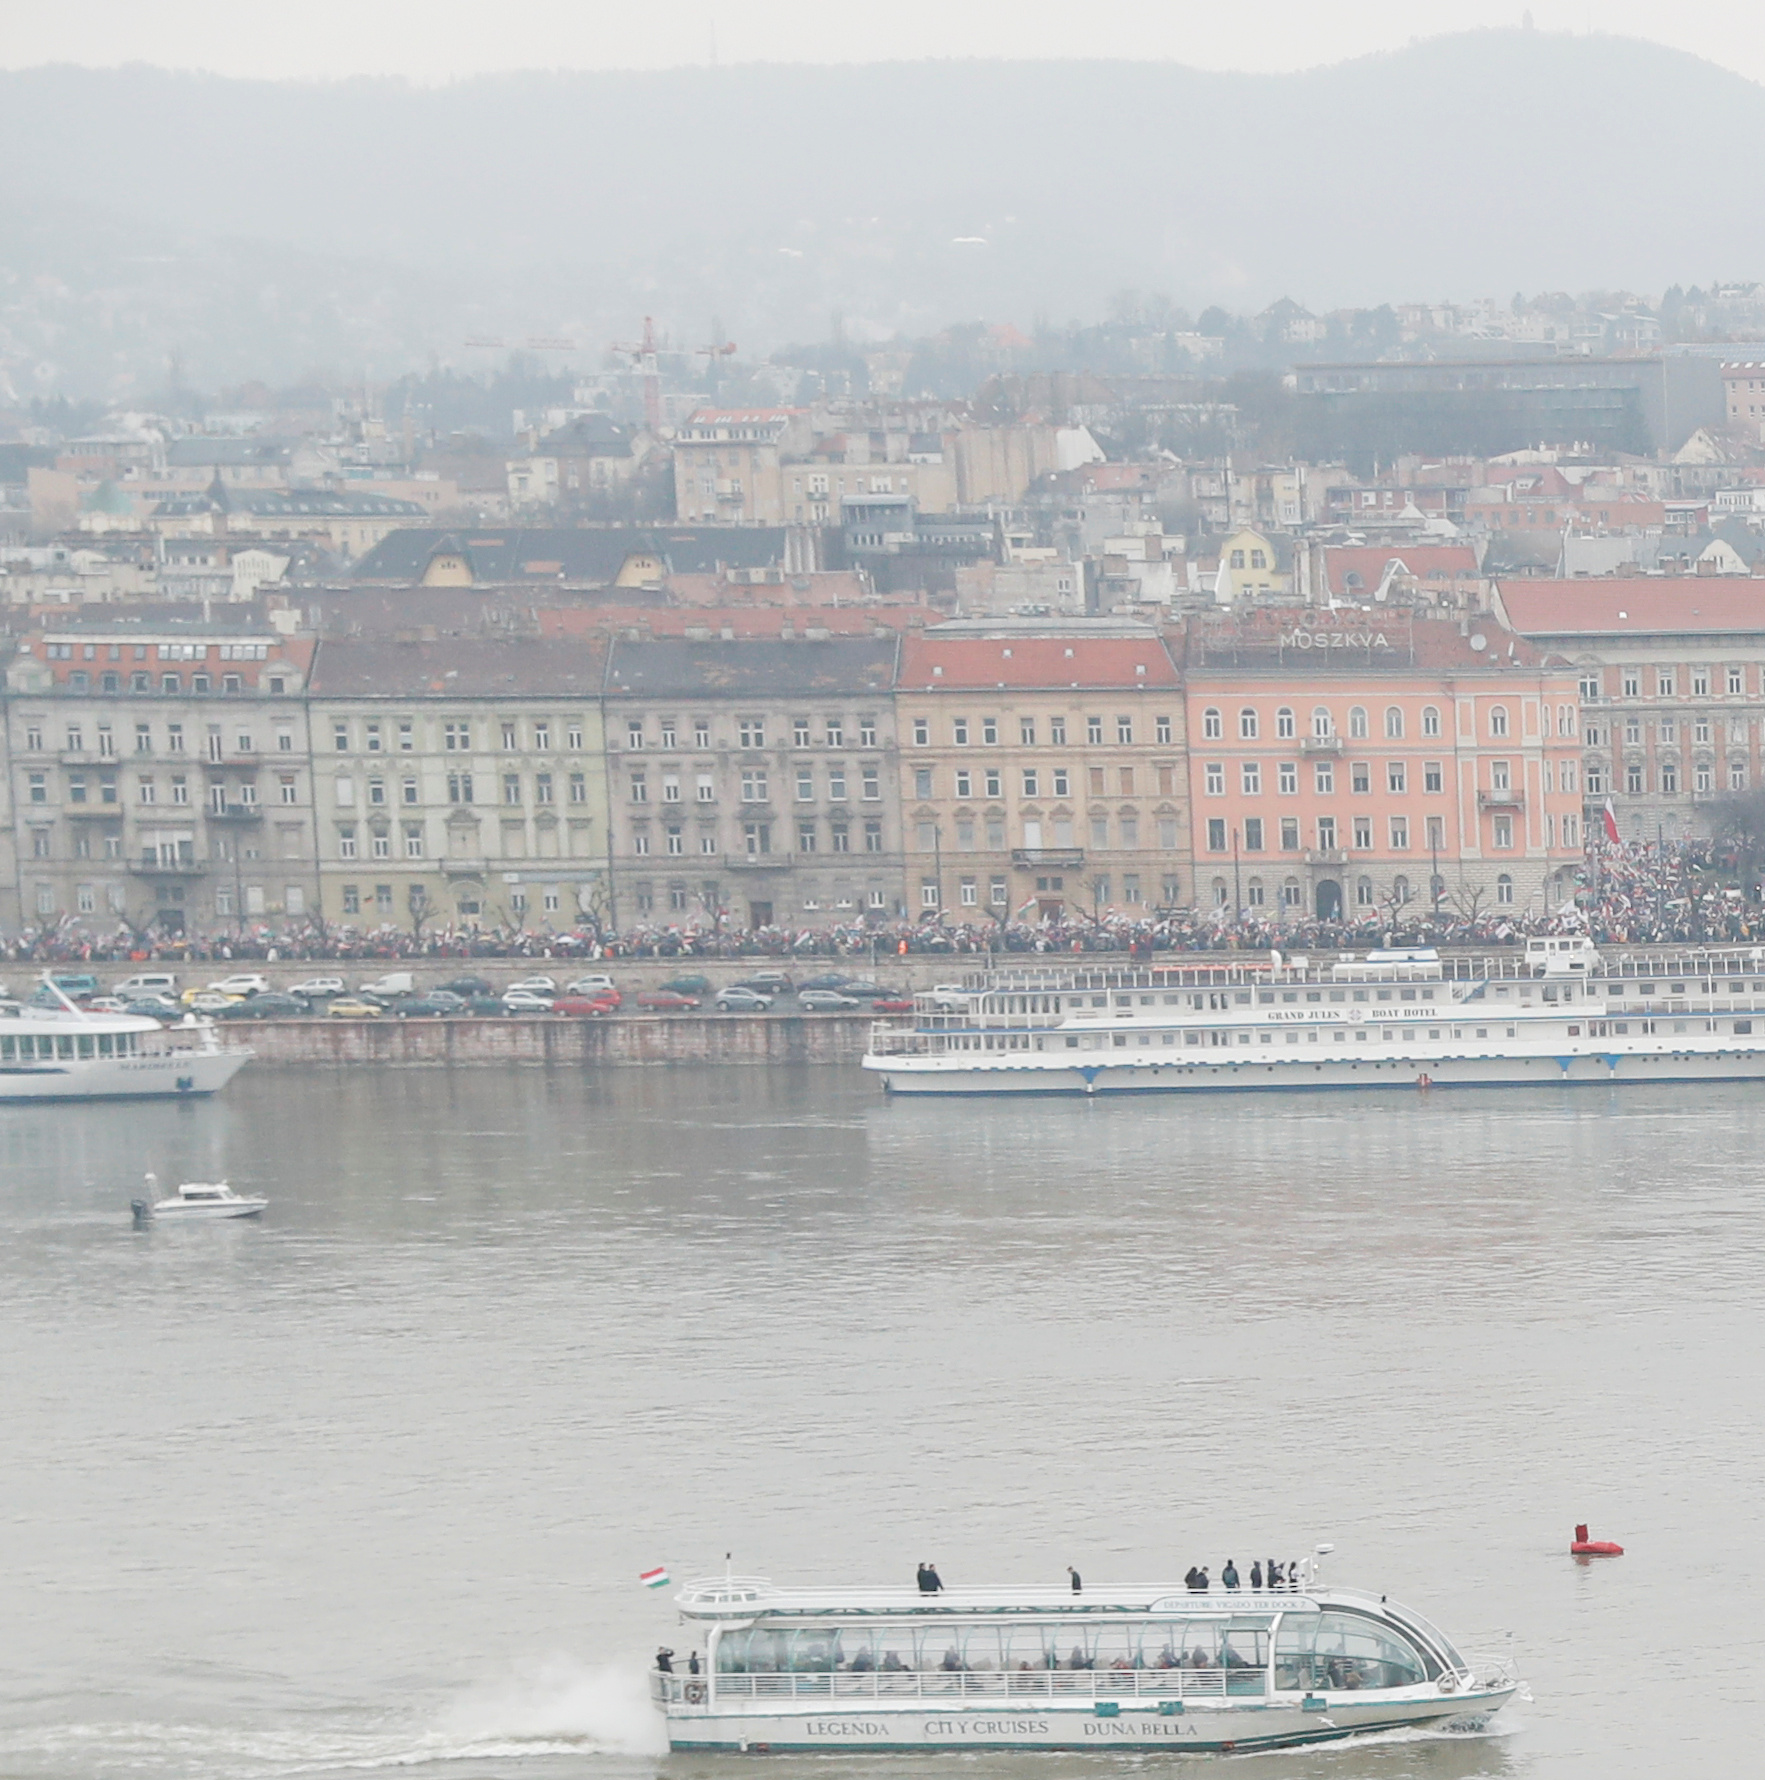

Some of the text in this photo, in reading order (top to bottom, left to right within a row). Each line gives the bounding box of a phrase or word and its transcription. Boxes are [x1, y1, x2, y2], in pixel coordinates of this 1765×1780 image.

[1280, 633, 1388, 649] MOSZKVA
[1268, 1011, 1341, 1020] GRAND JULES
[1372, 1008, 1439, 1019] BOAT HOTEL
[807, 1720, 1198, 1736] LEGENDA CITY CRUISES DUNA BELLA
